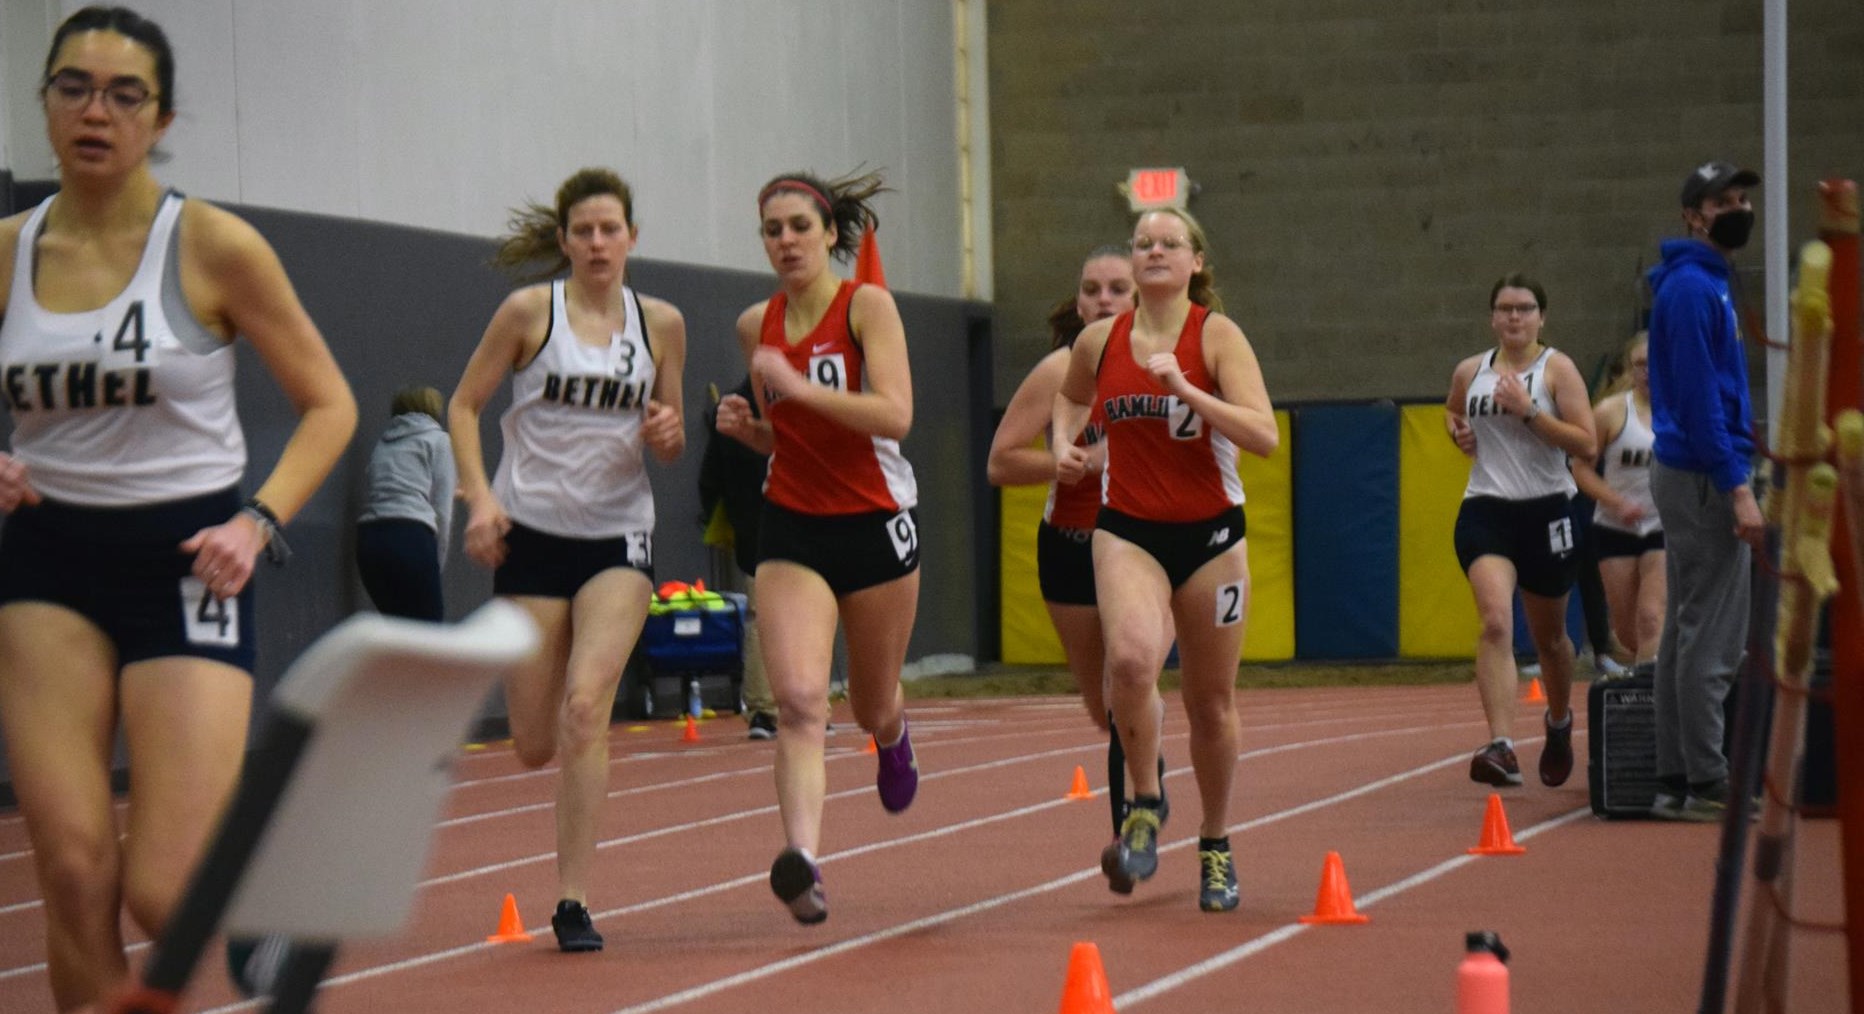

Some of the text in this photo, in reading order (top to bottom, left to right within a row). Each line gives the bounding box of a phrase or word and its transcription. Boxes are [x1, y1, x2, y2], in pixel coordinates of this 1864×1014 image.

[1139, 169, 1177, 199] EXIT
[113, 301, 150, 362] 4
[614, 340, 636, 377] 3
[817, 358, 839, 391] 9
[3, 361, 156, 412] ETHEL
[1524, 372, 1534, 394] 1
[1103, 394, 1170, 422] HAMLI
[1176, 398, 1197, 437] 2
[895, 517, 914, 557] 9
[1554, 522, 1567, 549] 1
[197, 589, 230, 638] 4
[1222, 585, 1240, 624] 2
